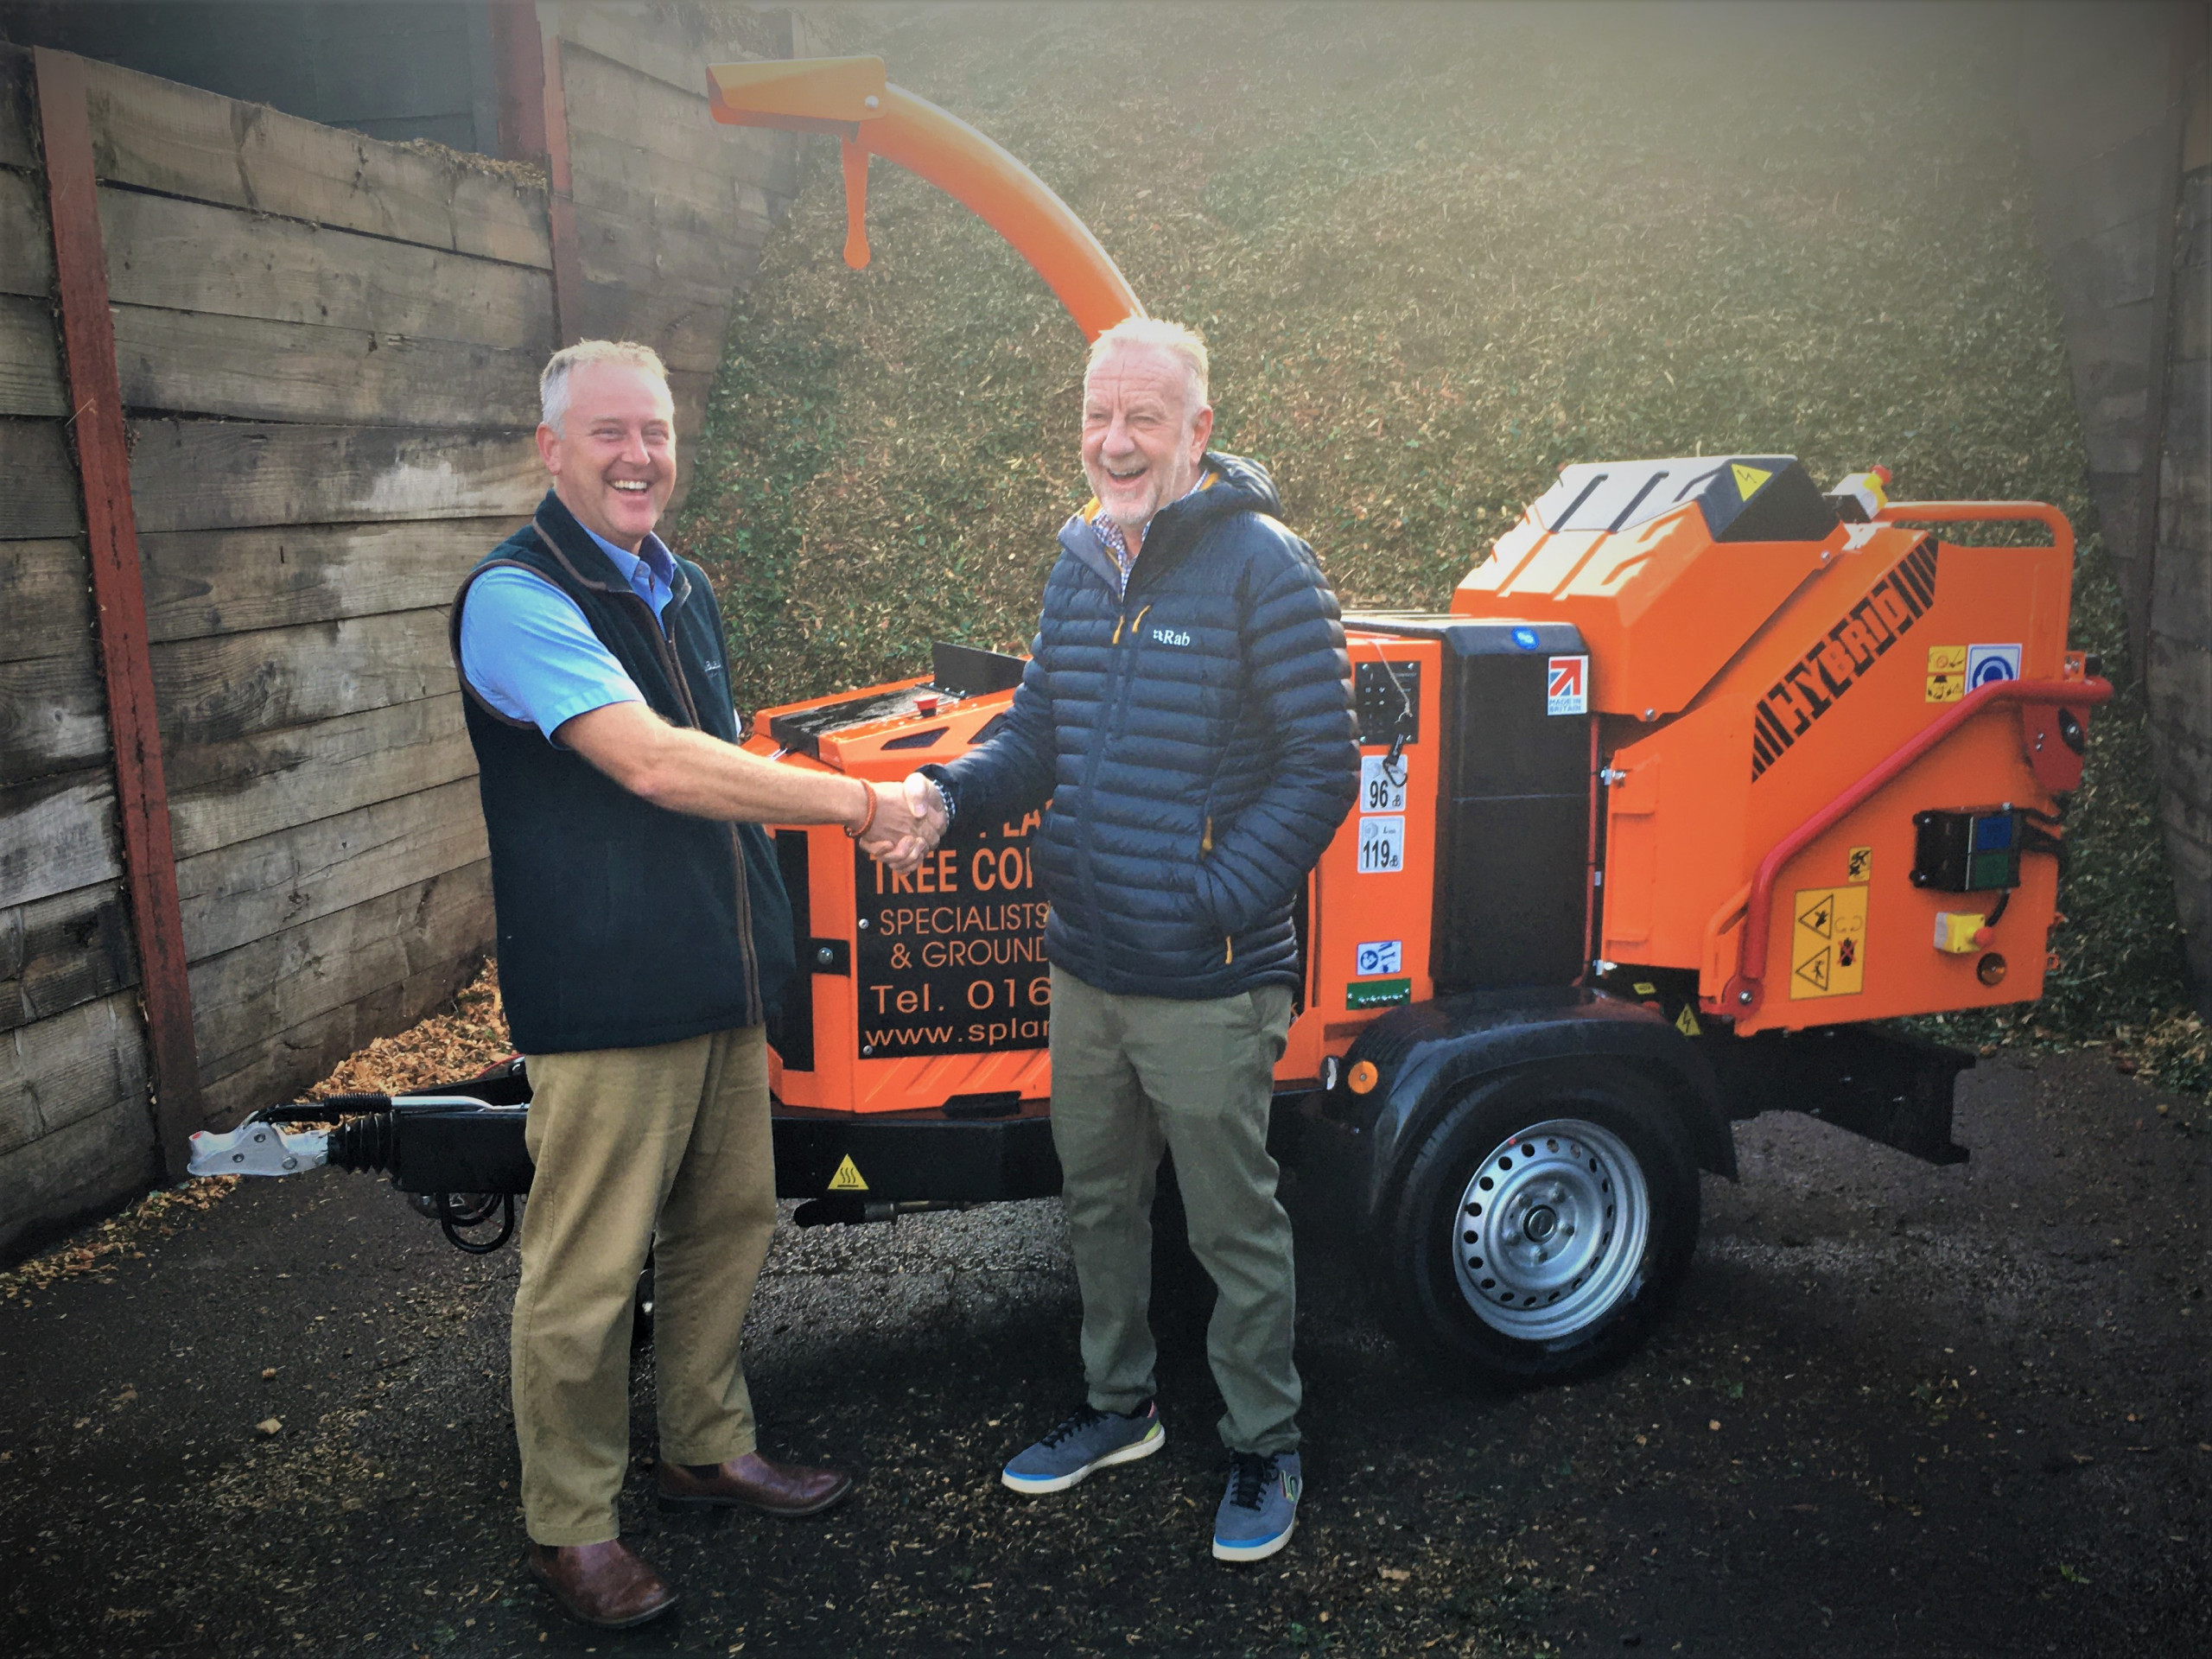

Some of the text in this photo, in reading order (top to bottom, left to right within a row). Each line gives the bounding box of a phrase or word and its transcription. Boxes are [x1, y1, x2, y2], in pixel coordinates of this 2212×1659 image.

[1163, 630, 1191, 646] Rab
[1768, 582, 1912, 737] HYBRID
[1370, 780, 1389, 808] 96
[1363, 840, 1390, 868] 119
[891, 943, 912, 969] &
[870, 983, 944, 1014] Tel.
